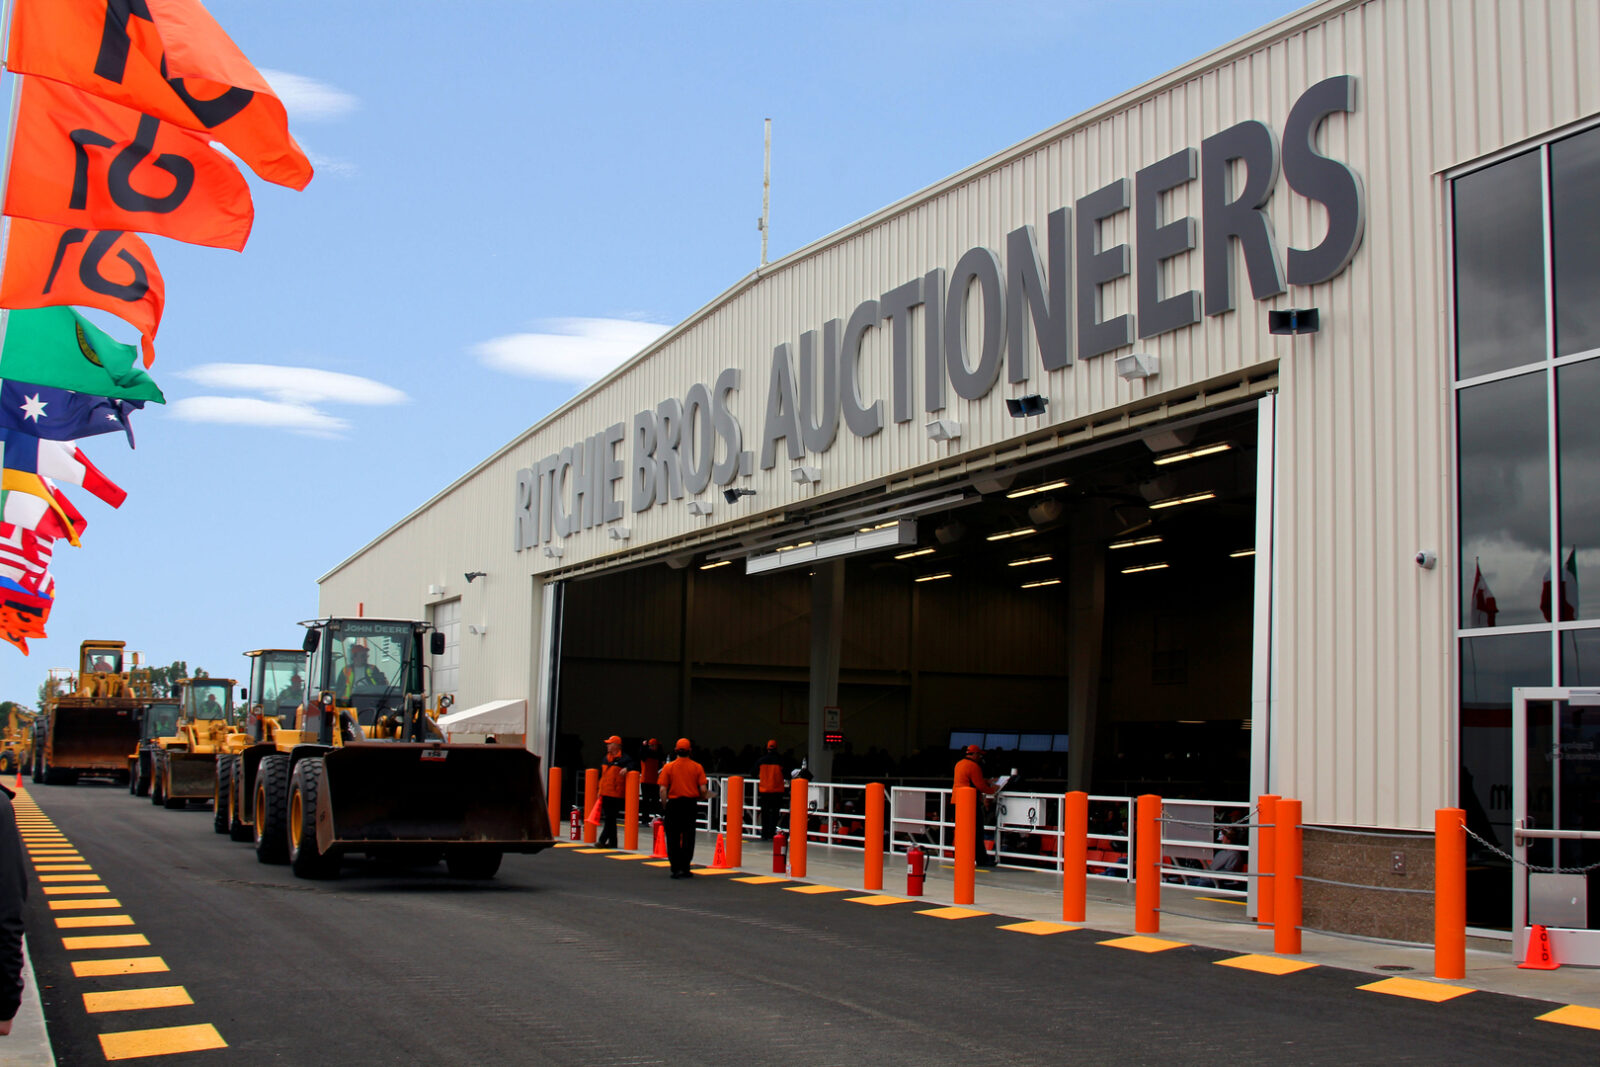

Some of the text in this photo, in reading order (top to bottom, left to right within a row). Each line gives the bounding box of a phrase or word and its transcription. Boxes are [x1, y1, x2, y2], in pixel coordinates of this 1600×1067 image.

[514, 75, 1364, 553] RITCHIE BROS. AUCTIONEERS
[345, 623, 409, 634] JOHN DEERE
